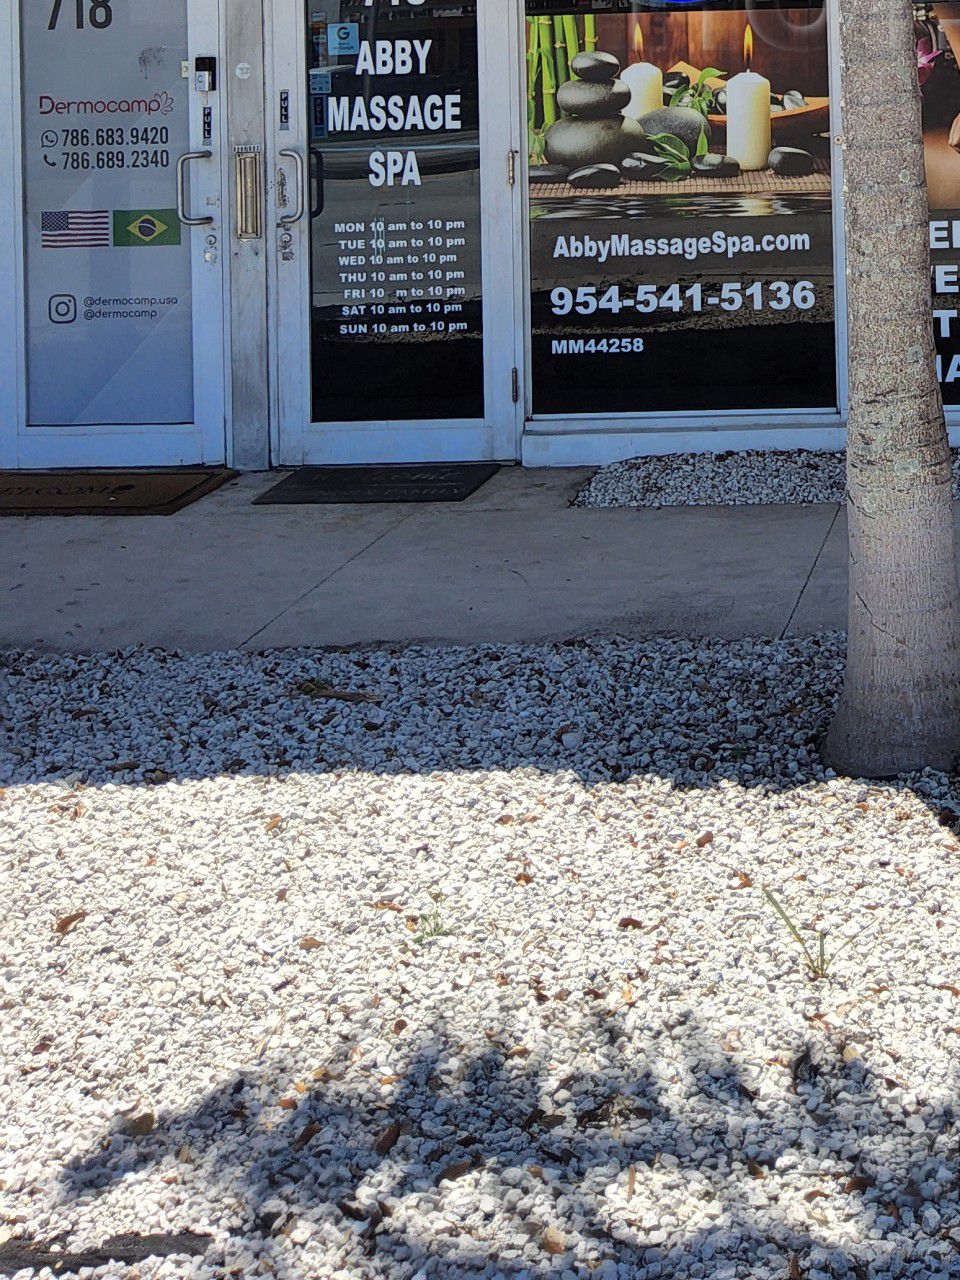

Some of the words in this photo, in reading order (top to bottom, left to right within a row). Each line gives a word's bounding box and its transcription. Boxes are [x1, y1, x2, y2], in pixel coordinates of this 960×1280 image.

[355, 39, 432, 75] ABBY
[39, 96, 161, 115] Dermocamp
[327, 94, 462, 132] MASSAGE
[62, 127, 169, 147] 786.683.9420
[62, 150, 169, 170] 786.689.2340
[368, 151, 422, 187] SPA
[335, 223, 364, 232] MON
[370, 222, 384, 231] 10
[388, 223, 406, 231] am
[411, 221, 423, 230] to
[427, 220, 442, 229] 10
[446, 221, 464, 231] pm
[339, 240, 365, 249] TUE
[370, 239, 385, 248] 10
[388, 240, 407, 248] am
[411, 238, 423, 247] to
[428, 237, 442, 246] 10
[447, 238, 465, 248] pm
[553, 230, 810, 262] AbbyMassageSpa.com
[339, 256, 365, 265] WED
[370, 255, 383, 264] 10
[407, 255, 418, 263] to
[423, 253, 436, 262] 10
[440, 254, 457, 264] pm
[339, 273, 366, 282] THU
[371, 272, 385, 281] 10
[389, 273, 407, 281] am
[411, 271, 423, 279] to
[428, 270, 442, 279] 10
[446, 271, 464, 280] pm
[344, 290, 365, 298] FRI
[370, 289, 384, 298] 10
[411, 288, 423, 296] to
[428, 286, 442, 295] 10
[447, 287, 465, 297] pm
[550, 281, 816, 315] 954-541-5136
[84, 296, 178, 307] @dermocamp.usa
[84, 309, 157, 320] @dermocamp
[342, 306, 366, 315] SAT
[371, 305, 384, 314] 10
[410, 304, 422, 313] to
[426, 303, 440, 312] 10
[444, 304, 462, 313] pm
[340, 325, 367, 334] SUN
[372, 324, 386, 332] 10
[391, 324, 409, 332] am
[413, 323, 425, 331] to
[430, 322, 444, 330] 10
[449, 322, 467, 332] pm
[551, 338, 644, 354] MM44258
